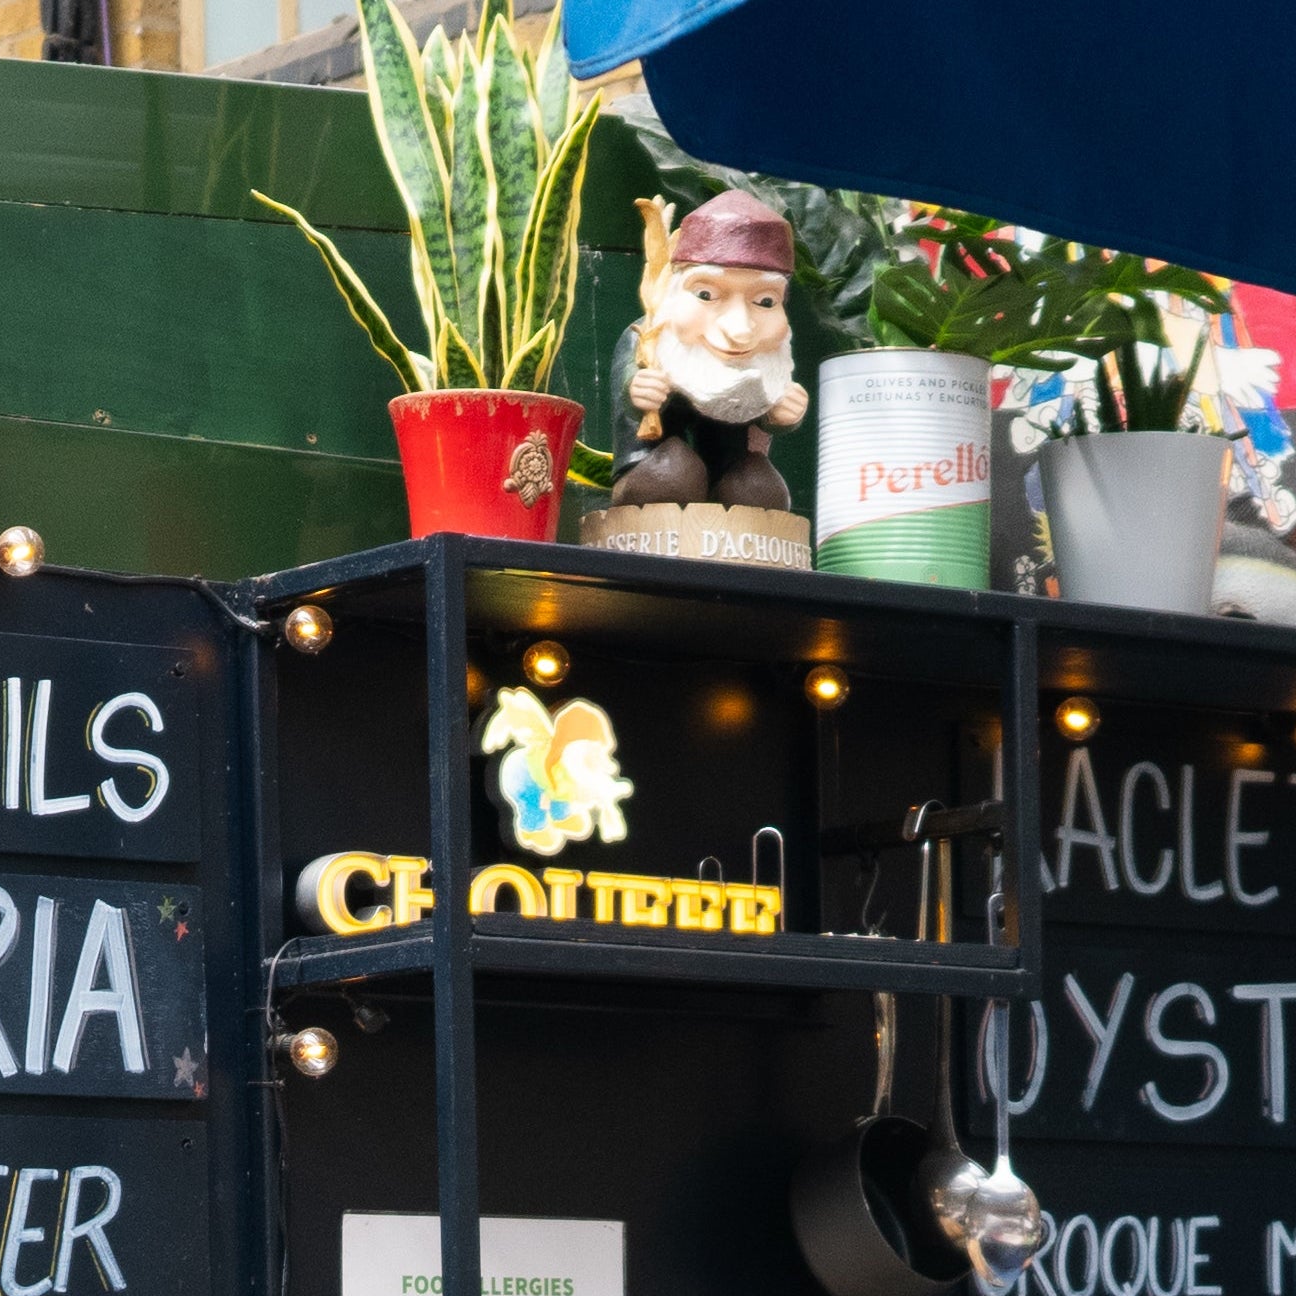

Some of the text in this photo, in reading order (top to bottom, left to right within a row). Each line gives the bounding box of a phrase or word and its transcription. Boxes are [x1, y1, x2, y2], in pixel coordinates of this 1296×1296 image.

[865, 377, 913, 389] OLIVES
[918, 378, 946, 388] AND
[848, 391, 921, 404] ACEITUNAS
[927, 392, 935, 402] Y
[858, 441, 989, 502] Perelló
[401, 1275, 575, 1296] FOO LLERGIES
